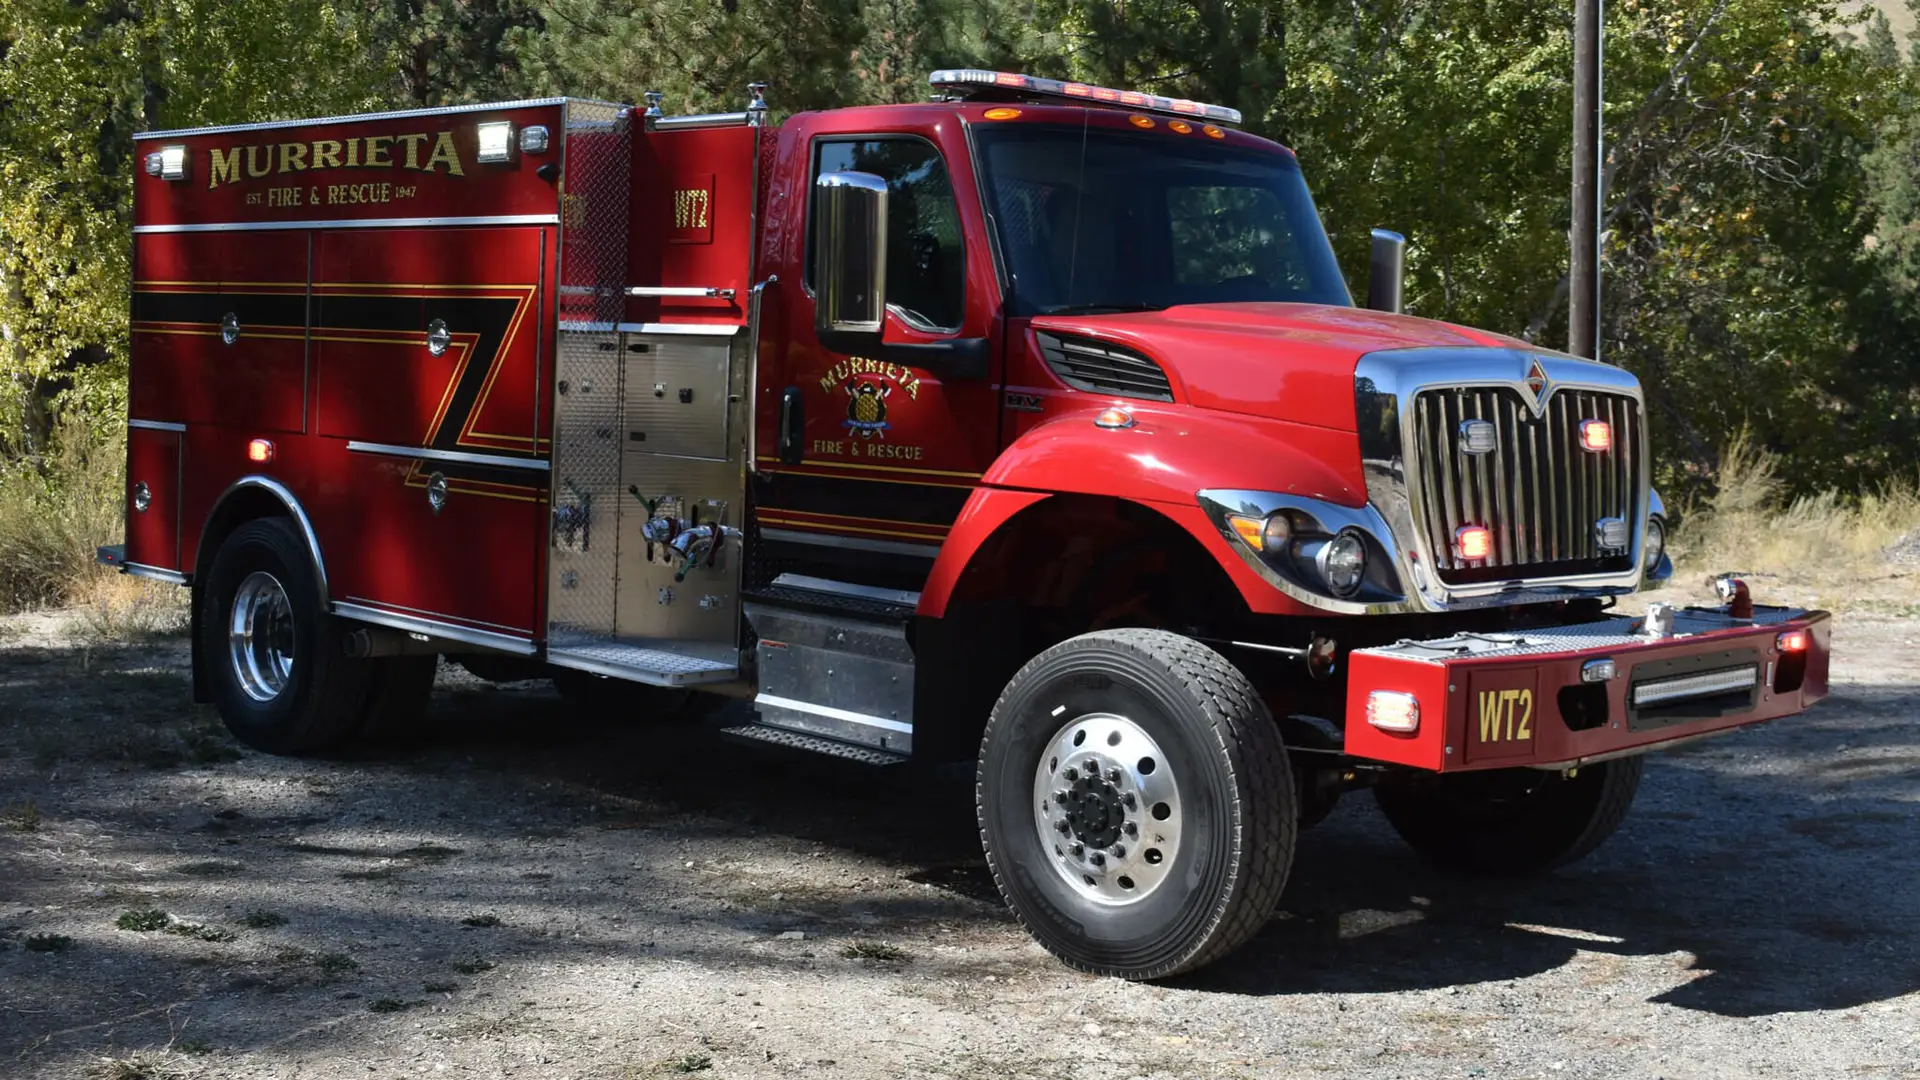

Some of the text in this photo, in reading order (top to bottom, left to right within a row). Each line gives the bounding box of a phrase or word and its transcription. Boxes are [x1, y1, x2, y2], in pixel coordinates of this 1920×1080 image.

[209, 131, 465, 189] MURRIETA
[268, 187, 303, 208] FIRE
[310, 186, 320, 205] &
[328, 182, 392, 204] RESCUE
[675, 189, 708, 228] WT2
[819, 356, 921, 401] MURRIETA
[813, 439, 923, 461] FIRE & RESCUE
[1479, 688, 1533, 742] WT2
